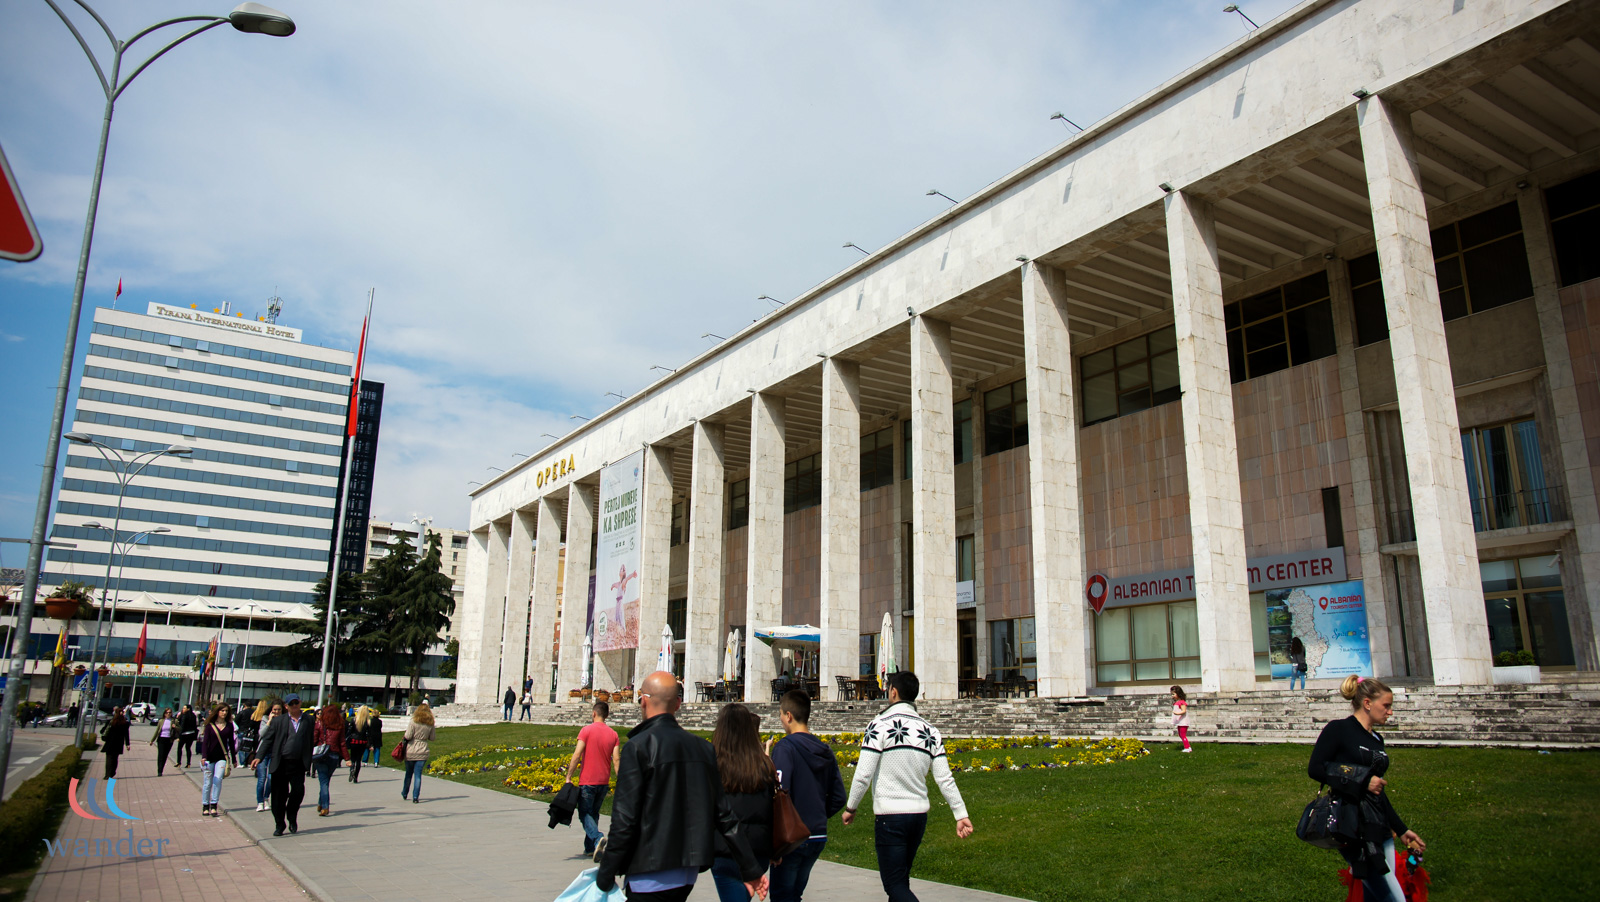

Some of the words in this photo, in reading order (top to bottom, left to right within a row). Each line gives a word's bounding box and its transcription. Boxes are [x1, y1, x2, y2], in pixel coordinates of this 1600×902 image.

[195, 313, 262, 332] INTERNATIONAL
[266, 326, 295, 339] HOTEL
[536, 453, 576, 488] OPERA
[603, 516, 612, 534] KA
[1114, 576, 1182, 599] ALBANIAN
[1266, 557, 1333, 581] CENTER
[1329, 594, 1362, 604] ALBANIAN
